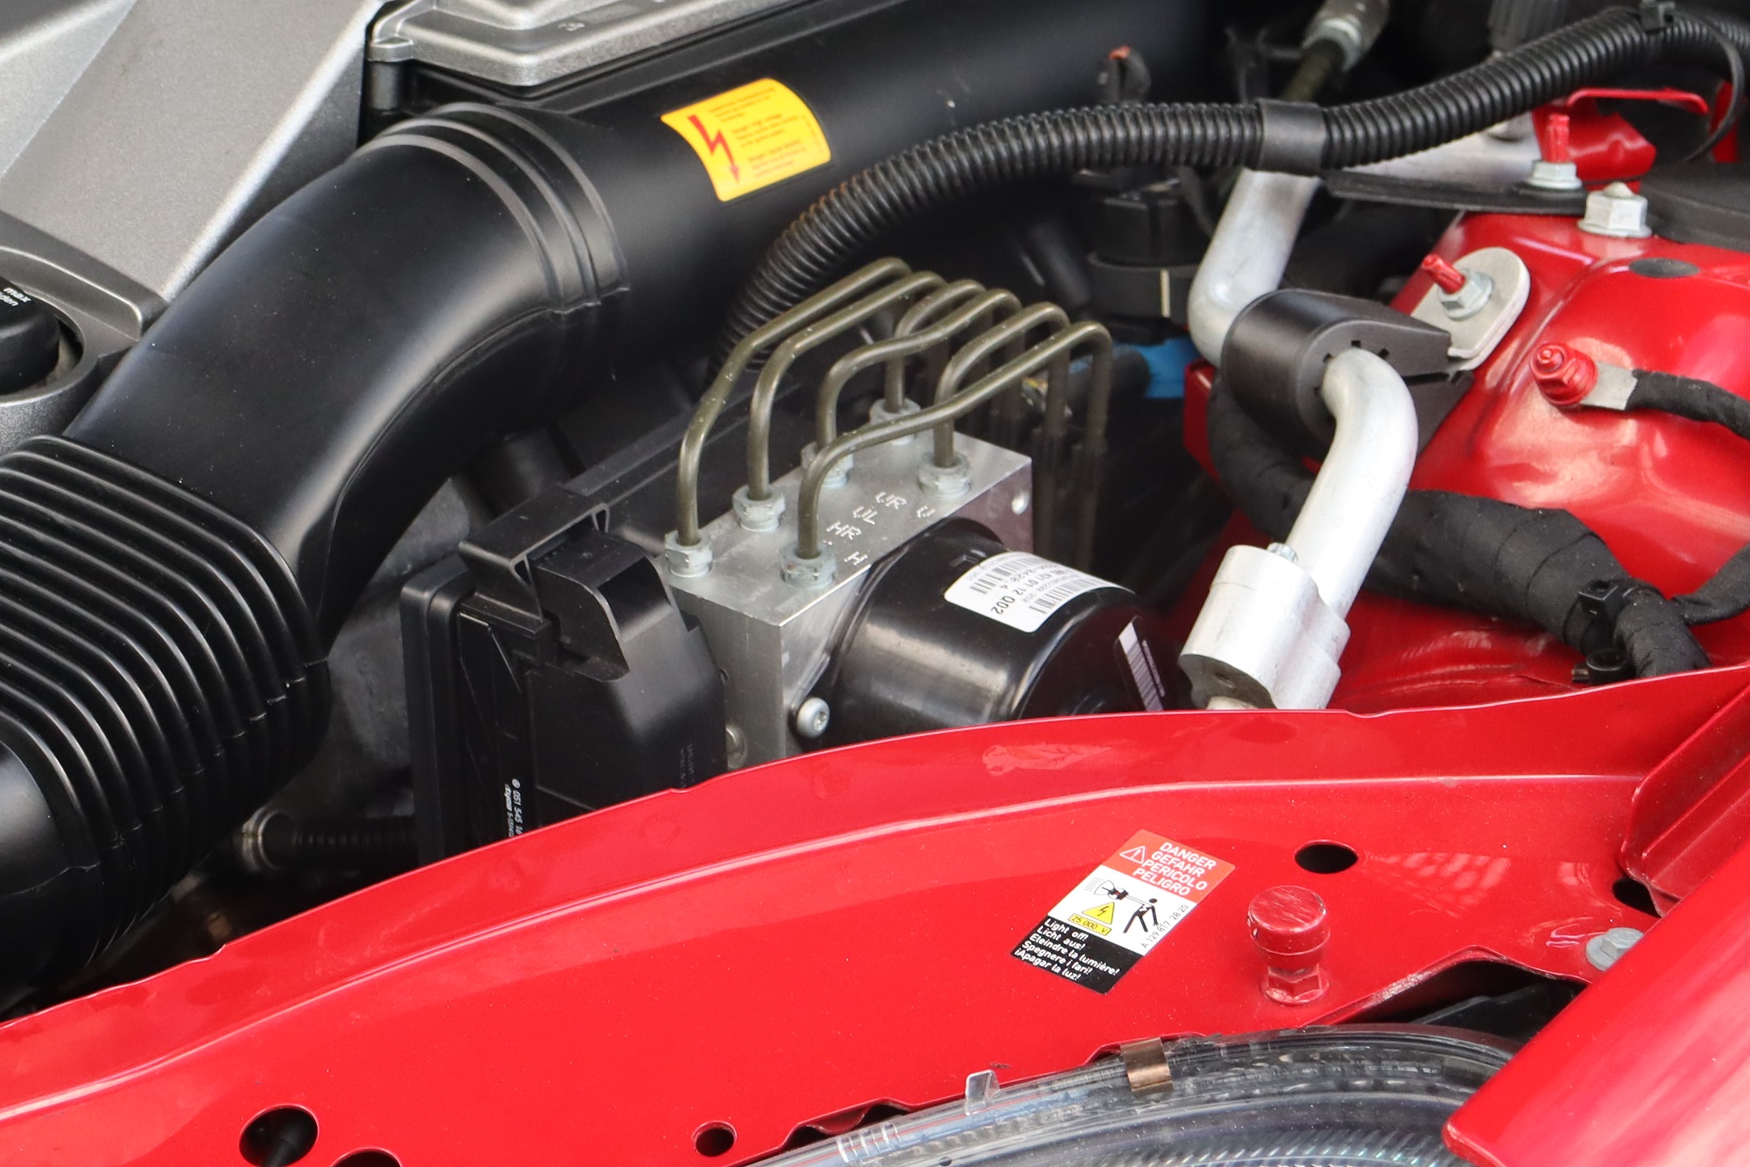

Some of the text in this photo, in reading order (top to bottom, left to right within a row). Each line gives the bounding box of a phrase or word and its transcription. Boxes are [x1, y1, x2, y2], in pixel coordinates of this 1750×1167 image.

[3, 287, 31, 302] max
[1151, 851, 1205, 877] GEFAHR
[1159, 842, 1217, 870] DANGER
[1132, 868, 1190, 895] PELIGRO
[1141, 859, 1208, 890] PERICOLO
[1037, 926, 1086, 950] Licht aus!
[1044, 918, 1089, 942] Light off!
[1083, 921, 1098, 929] 000
[1022, 940, 1066, 964] Spegnere
[1071, 962, 1093, 975] fari!
[1029, 933, 1120, 975] Eteindre la lumière!
[1051, 964, 1061, 973] la
[1062, 968, 1081, 981] luz!
